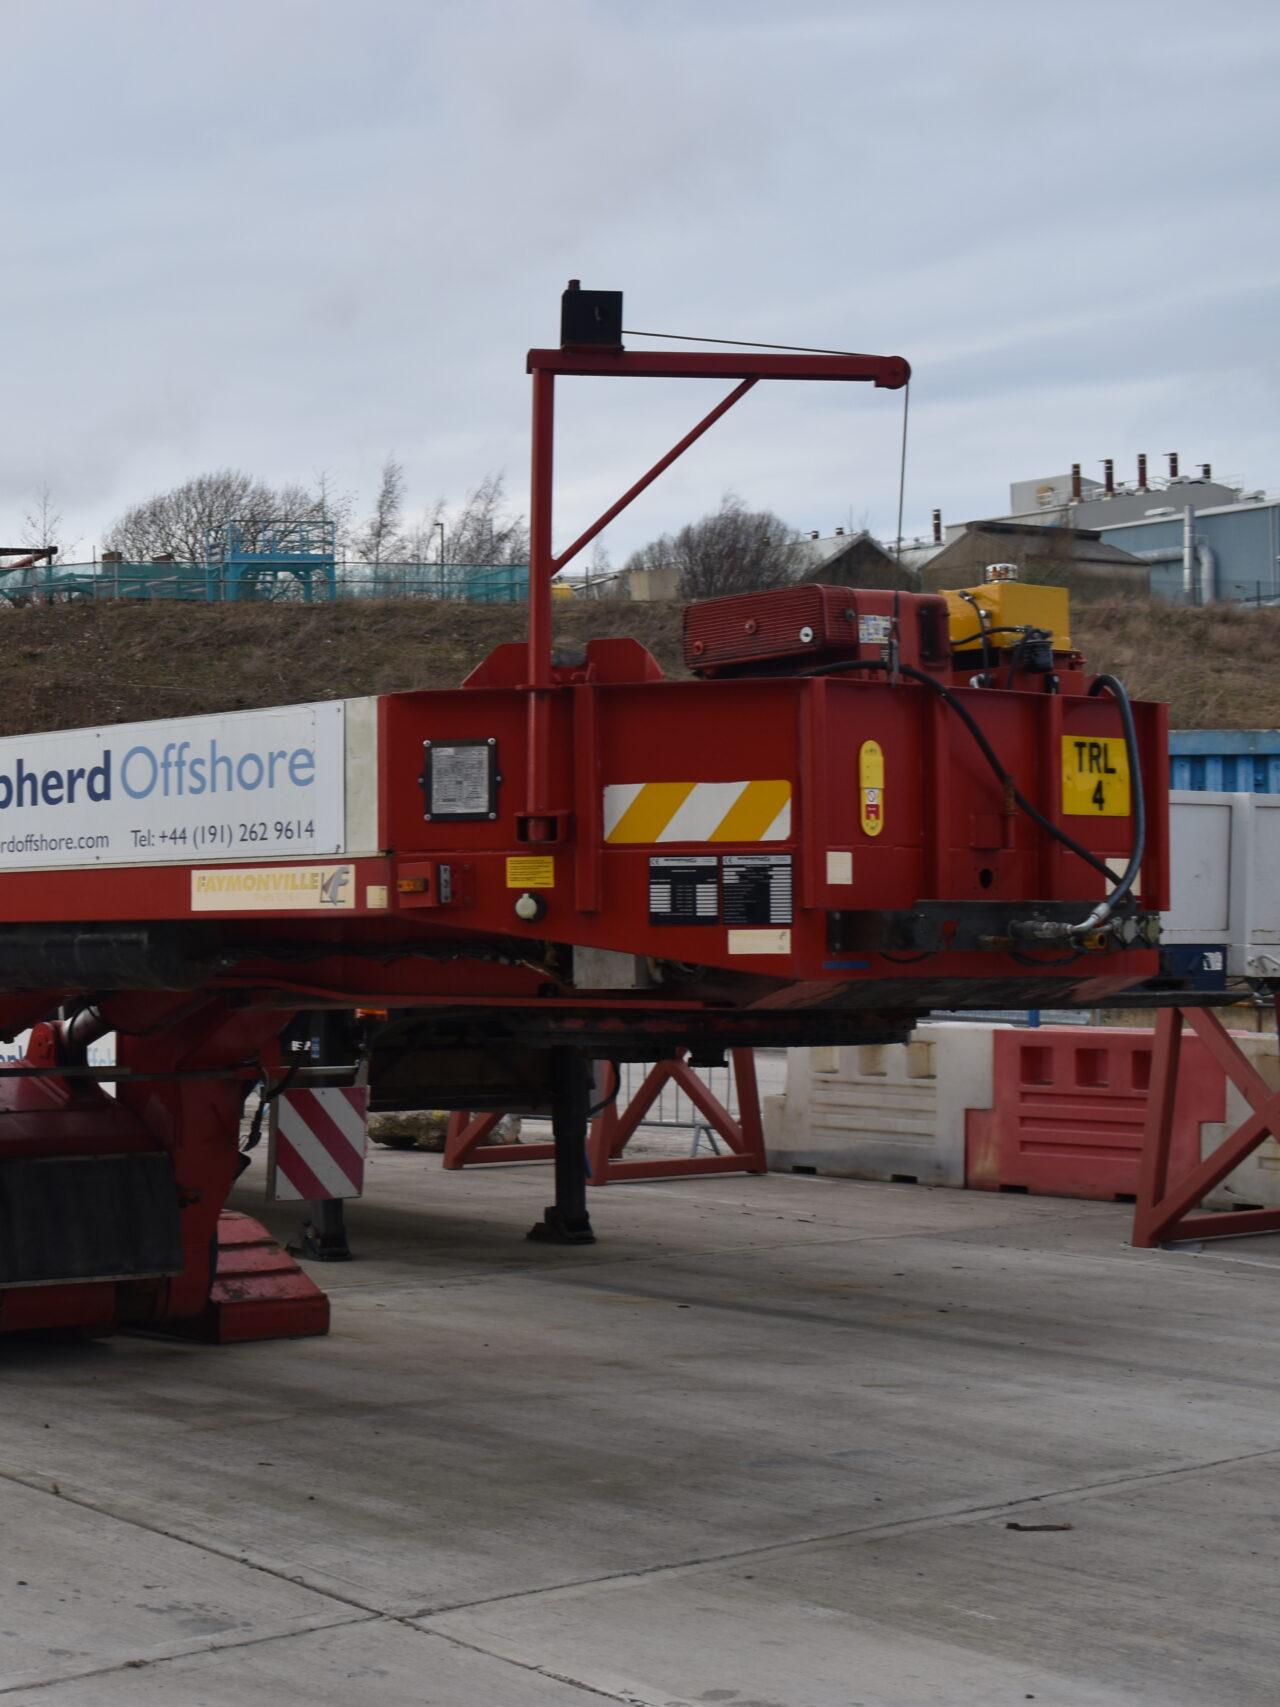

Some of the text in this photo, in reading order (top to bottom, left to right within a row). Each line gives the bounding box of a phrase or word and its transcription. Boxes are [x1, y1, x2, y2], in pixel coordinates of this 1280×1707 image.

[121, 739, 316, 799] Offshore
[1074, 741, 1117, 774] TRL
[1092, 780, 1105, 811] 4
[131, 819, 315, 850] Tel: +44 (191) 262 9614
[196, 872, 319, 893] FAYMONVILLE
